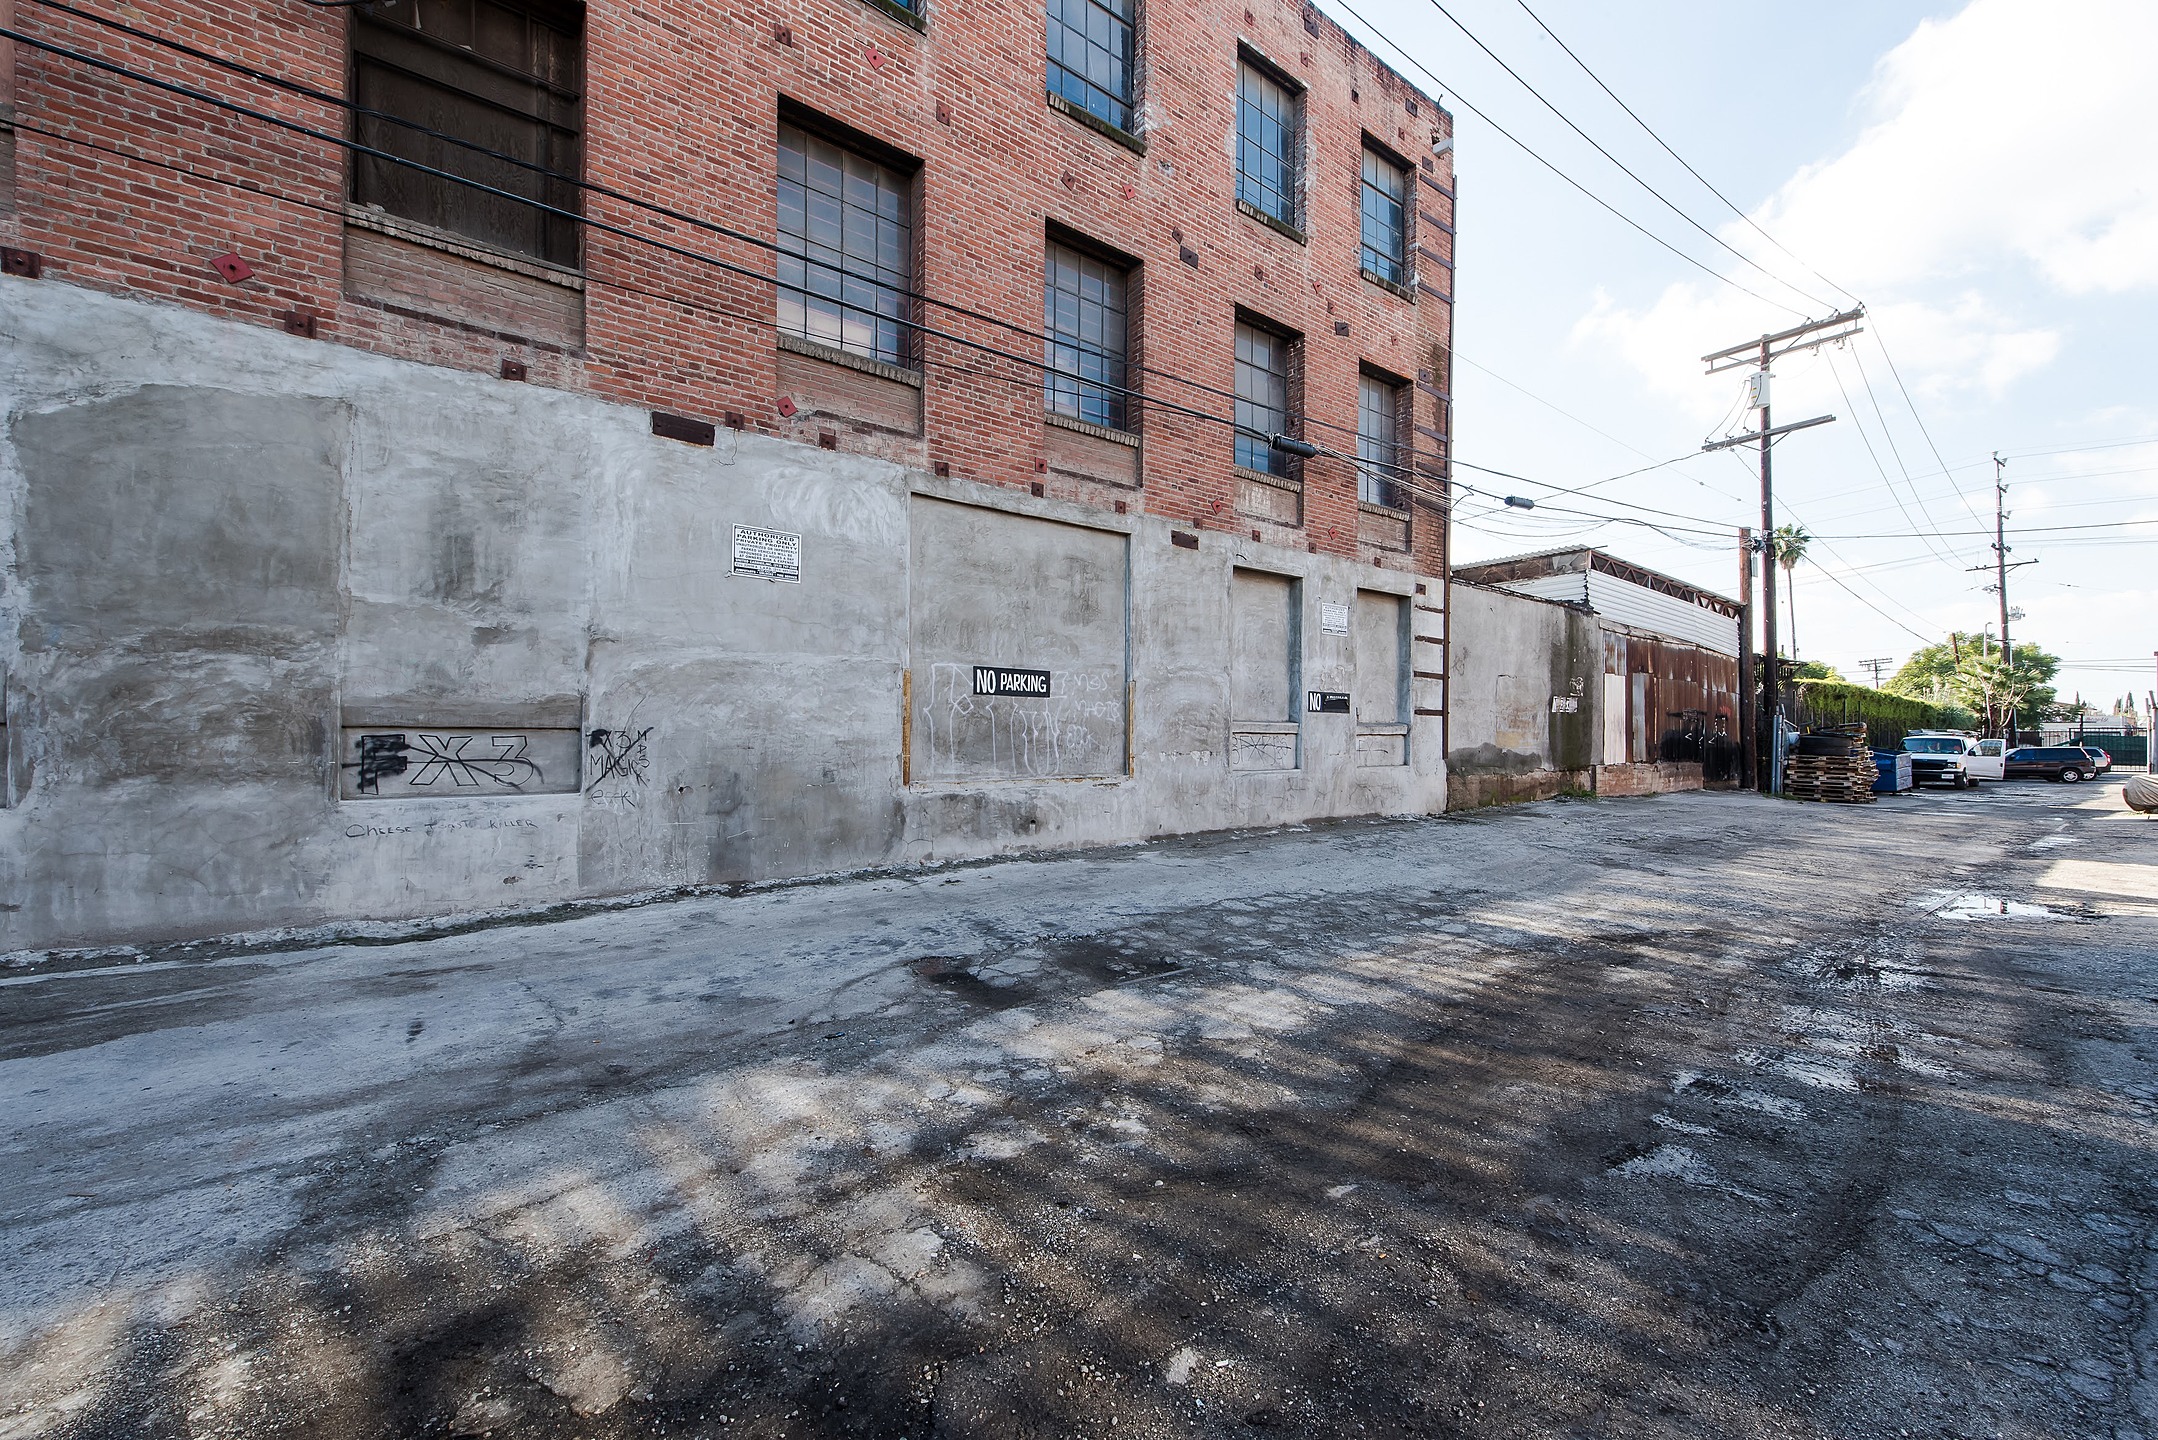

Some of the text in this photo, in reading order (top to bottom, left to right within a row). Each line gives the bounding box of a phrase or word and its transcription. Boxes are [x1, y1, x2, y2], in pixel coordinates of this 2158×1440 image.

[736, 533, 773, 543] PARKING
[740, 530, 795, 542] AUTHORIZED
[765, 542, 797, 550] PROPERTY
[976, 668, 1047, 694] NO PARKING
[1309, 692, 1321, 711] NO
